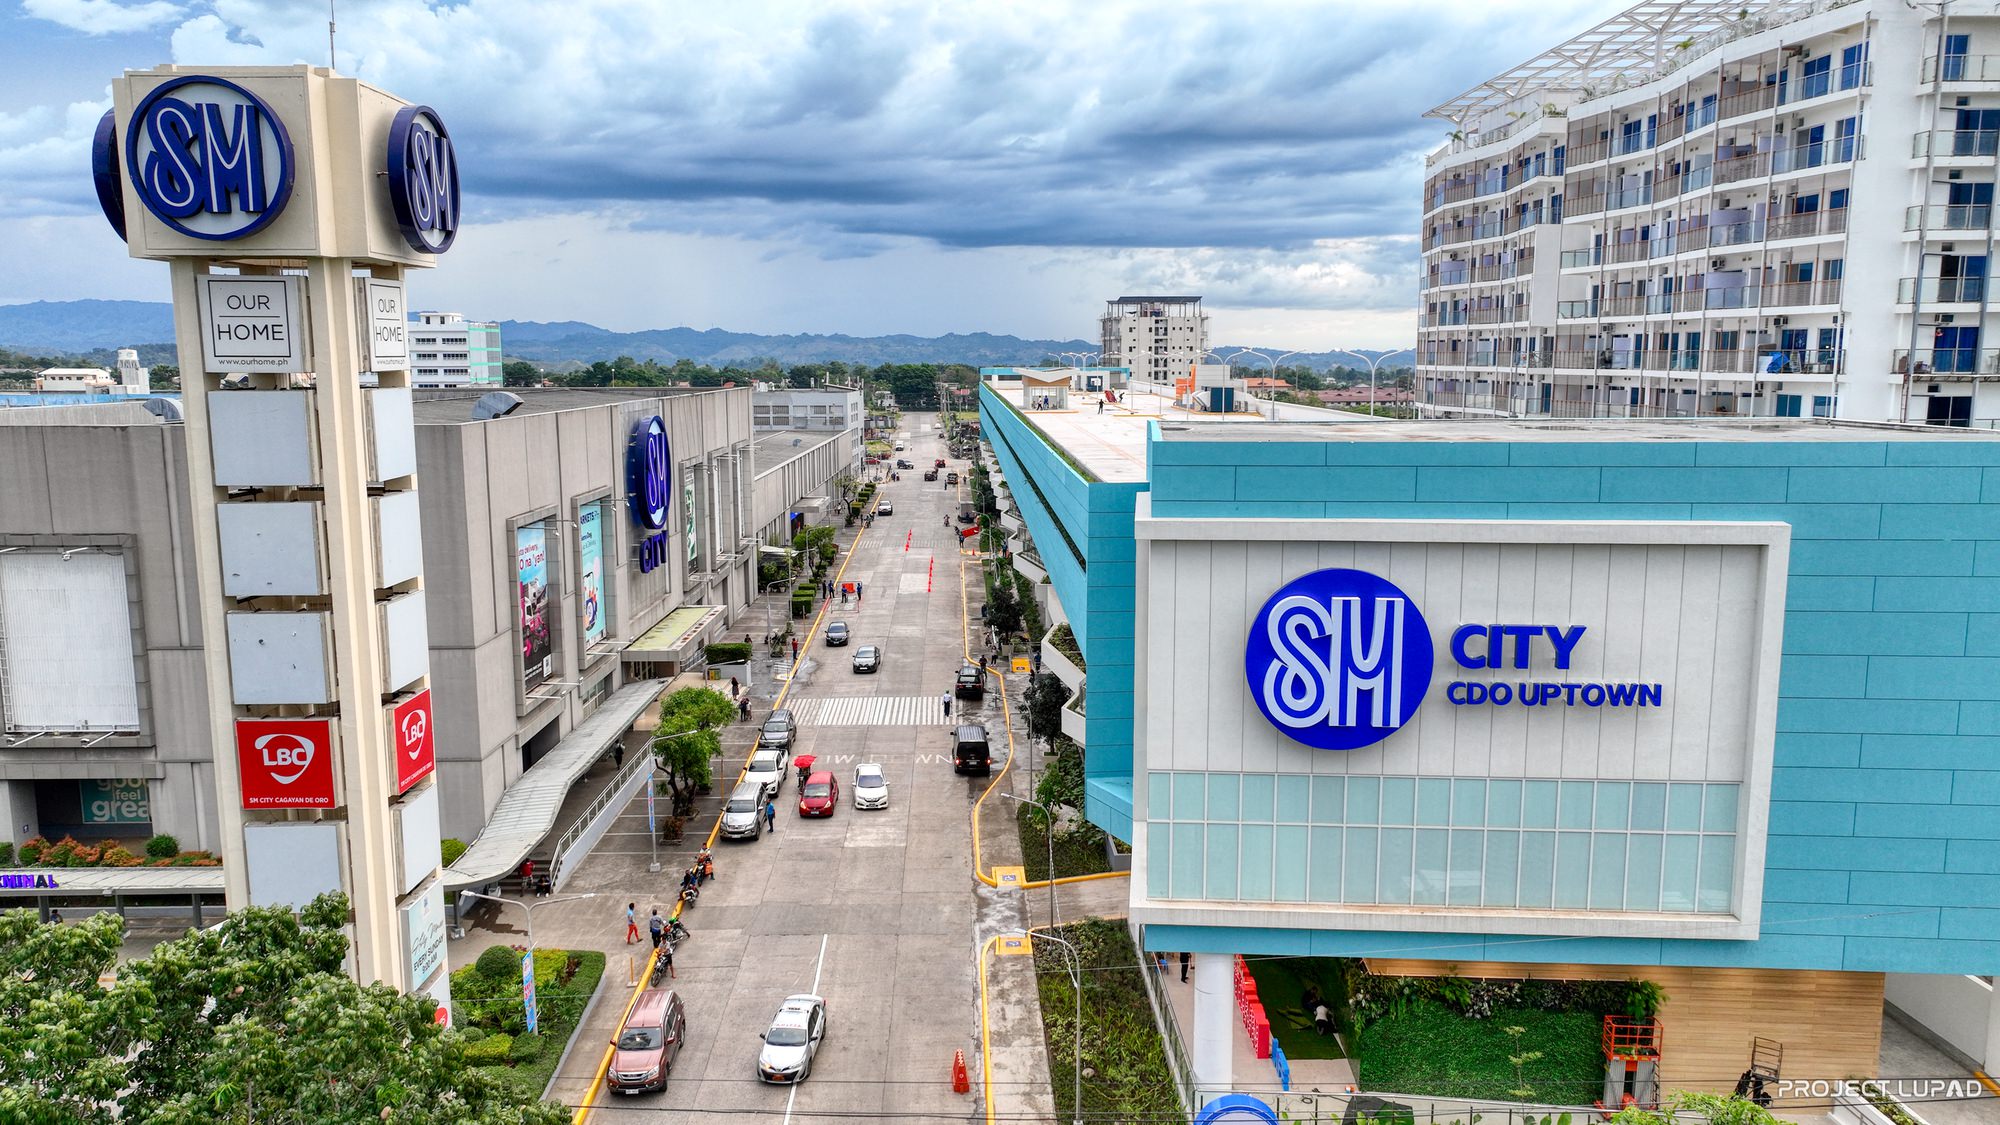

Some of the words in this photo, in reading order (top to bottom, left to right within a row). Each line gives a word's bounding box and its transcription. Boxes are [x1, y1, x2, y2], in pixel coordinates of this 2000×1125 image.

[144, 97, 267, 218] SM
[409, 122, 454, 231] SM
[227, 294, 270, 310] OUR
[377, 298, 396, 313] OUR
[217, 323, 285, 341] HOME
[375, 326, 403, 342] HOME
[218, 358, 288, 367] www.ourhome.ph
[647, 431, 668, 514] SM
[639, 530, 668, 574] CITY
[1449, 623, 1587, 670] CITY
[1263, 595, 1404, 729] SM
[1446, 681, 1513, 706] CDO
[1518, 682, 1662, 708] UPTOWN
[405, 720, 423, 747] LBC
[262, 748, 308, 766] LBC
[97, 778, 147, 791] goo
[115, 789, 141, 800] feel
[91, 800, 149, 821] grea
[427, 934, 444, 957] SUNDAY
